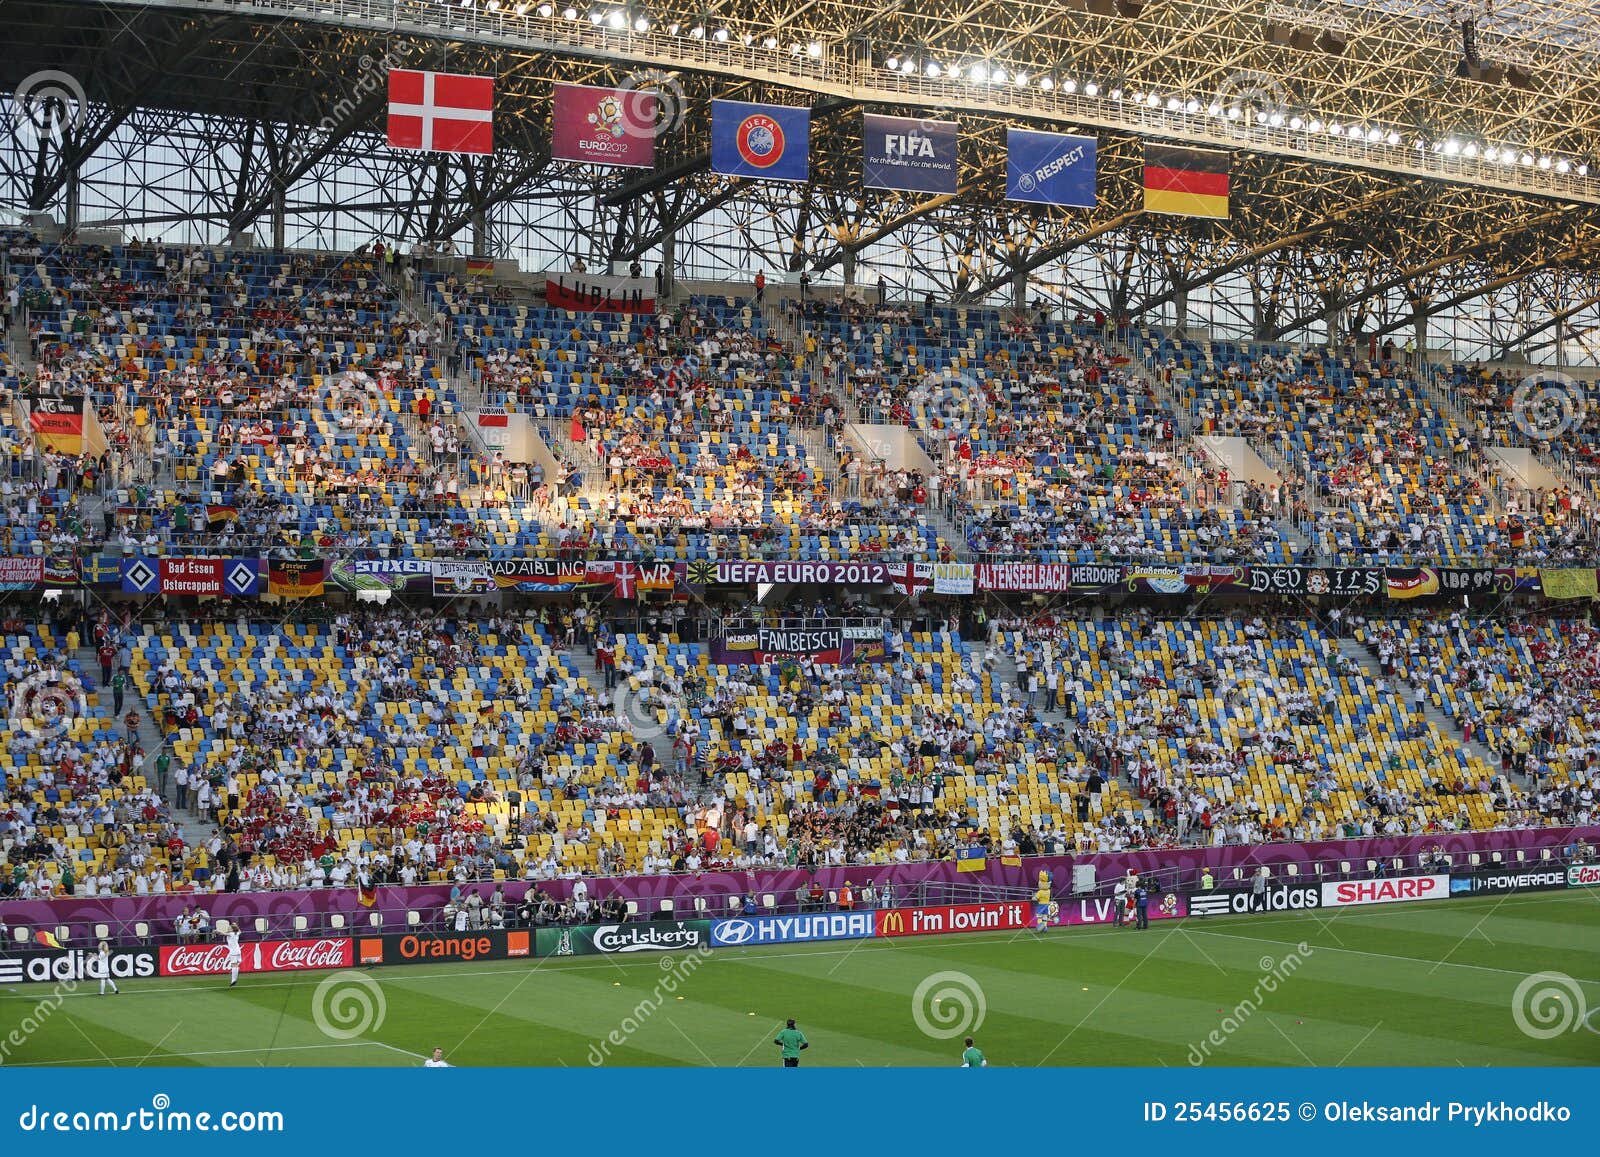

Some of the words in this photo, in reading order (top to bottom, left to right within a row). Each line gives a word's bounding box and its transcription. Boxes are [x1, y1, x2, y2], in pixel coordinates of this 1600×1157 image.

[745, 118, 775, 131] UEFA
[885, 134, 935, 158] FIFA
[869, 156, 880, 164] For
[880, 157, 890, 165] the
[911, 160, 921, 168] For
[921, 161, 932, 169] the
[1035, 146, 1085, 183] RESPECT
[559, 275, 643, 310] LUBLIN
[168, 561, 185, 574] Bad
[188, 561, 214, 574] Essen
[355, 560, 431, 573] STIXER
[439, 562, 485, 576] DEUTSCHLAND
[485, 561, 516, 577] BAD
[518, 560, 585, 577] AIBLING
[639, 563, 671, 585] WR
[716, 564, 769, 583] UEFA
[774, 564, 830, 583] EURO
[834, 565, 884, 583] 2012
[978, 564, 1068, 591] ALTENSEELBACH
[1071, 567, 1121, 584] HERDORF
[163, 579, 220, 592] Ostercappeln
[1487, 871, 1564, 889] POWERADE
[1579, 866, 1600, 883] Cas
[1337, 878, 1436, 903] SHARP
[758, 914, 873, 941] HYUNDAI
[912, 910, 943, 932] i'm
[949, 905, 1004, 930] lovin'
[1008, 905, 1023, 926] it
[400, 935, 492, 960] Orange
[593, 922, 699, 953] Carlsberg
[167, 945, 243, 973] Coca-Col
[271, 939, 346, 968] Coca-Cola
